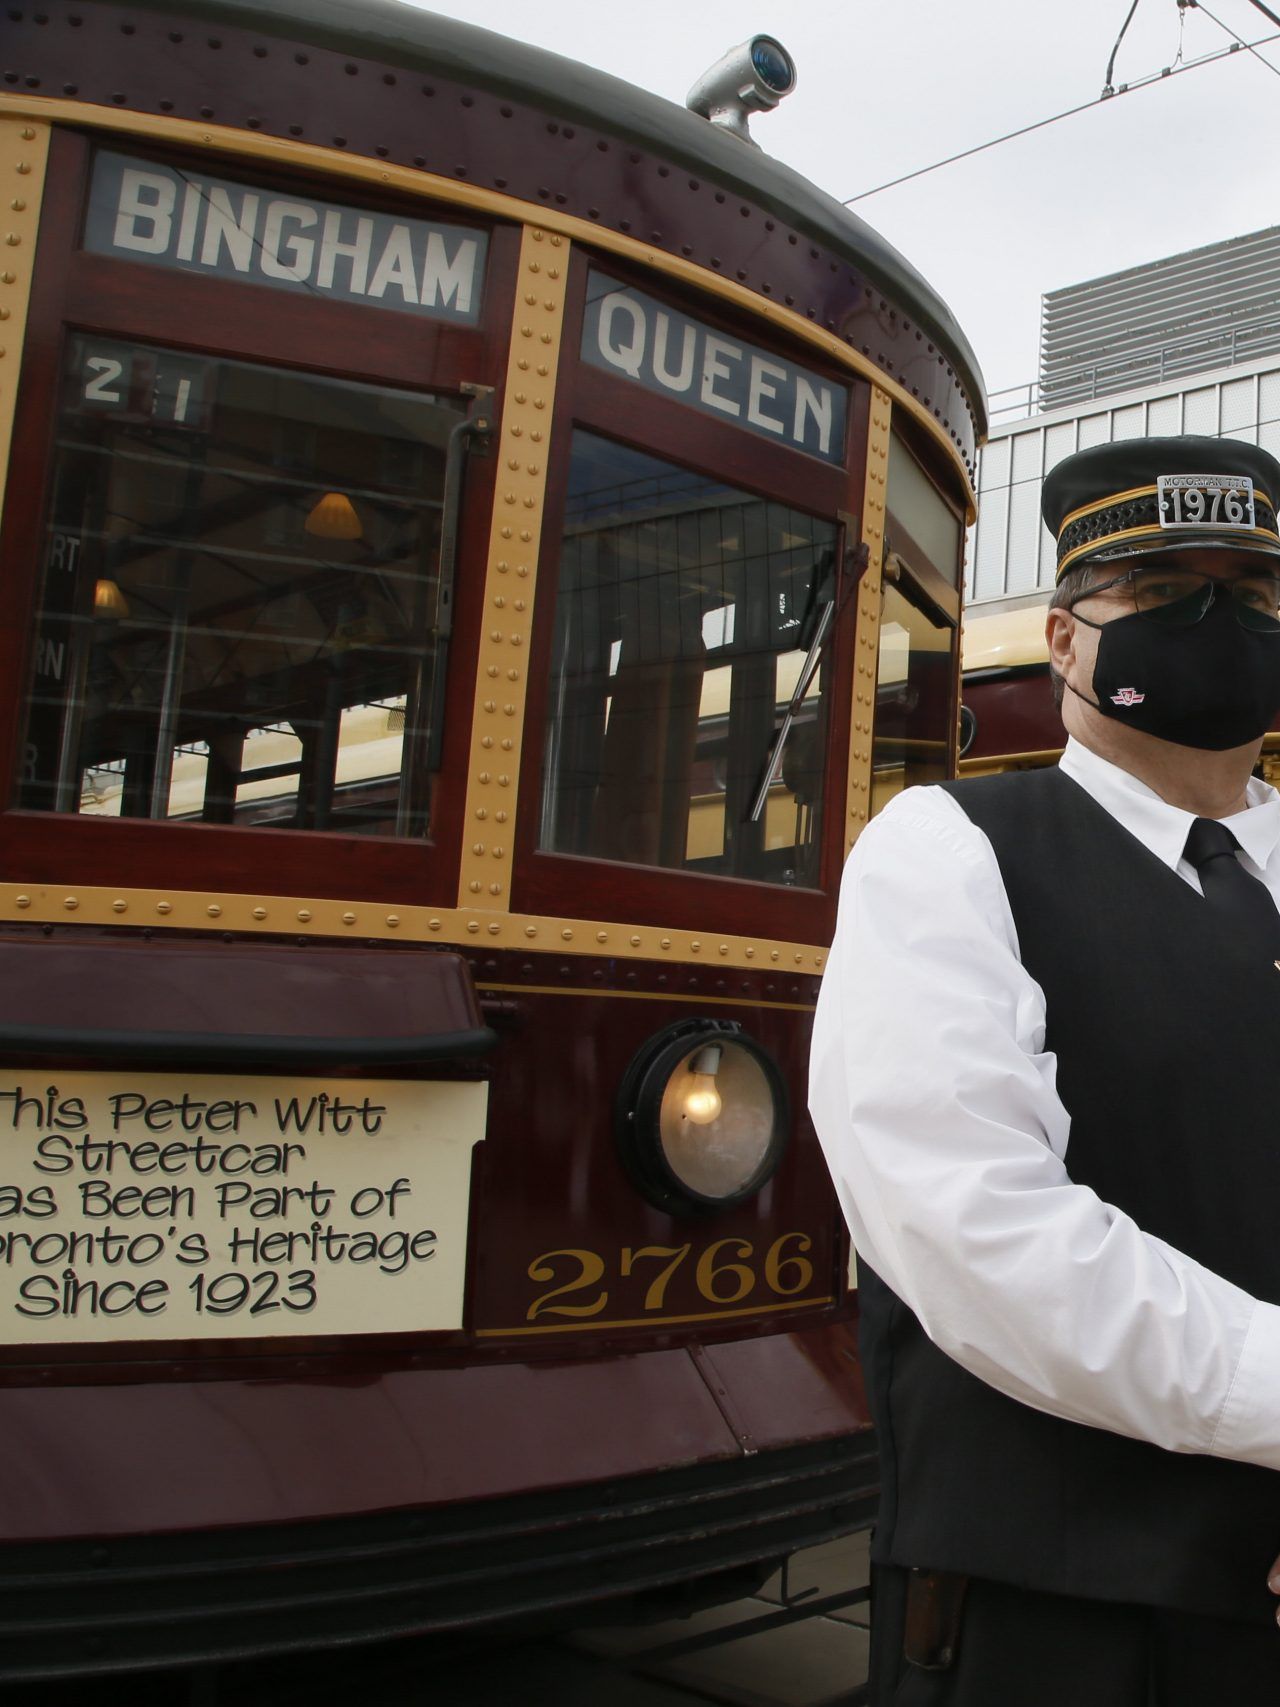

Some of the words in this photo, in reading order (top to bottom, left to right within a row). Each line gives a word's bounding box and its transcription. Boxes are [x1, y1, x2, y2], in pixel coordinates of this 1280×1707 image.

[112, 167, 477, 313] BINGHAM
[85, 356, 122, 402] 2
[597, 292, 833, 454] QUEEN
[1164, 477, 1222, 487] MOTORMAN
[1171, 488, 1244, 522] 1976
[108, 1093, 257, 1132] Peter
[274, 1093, 387, 1134] Witt
[33, 1134, 307, 1176] Streetcar
[79, 1180, 195, 1218] Been
[215, 1180, 336, 1219] Part
[350, 1178, 412, 1218] of
[228, 1221, 438, 1274] Heritage
[15, 1268, 168, 1317] Since
[189, 1269, 318, 1315] 1923
[526, 1232, 814, 1320] 2766
